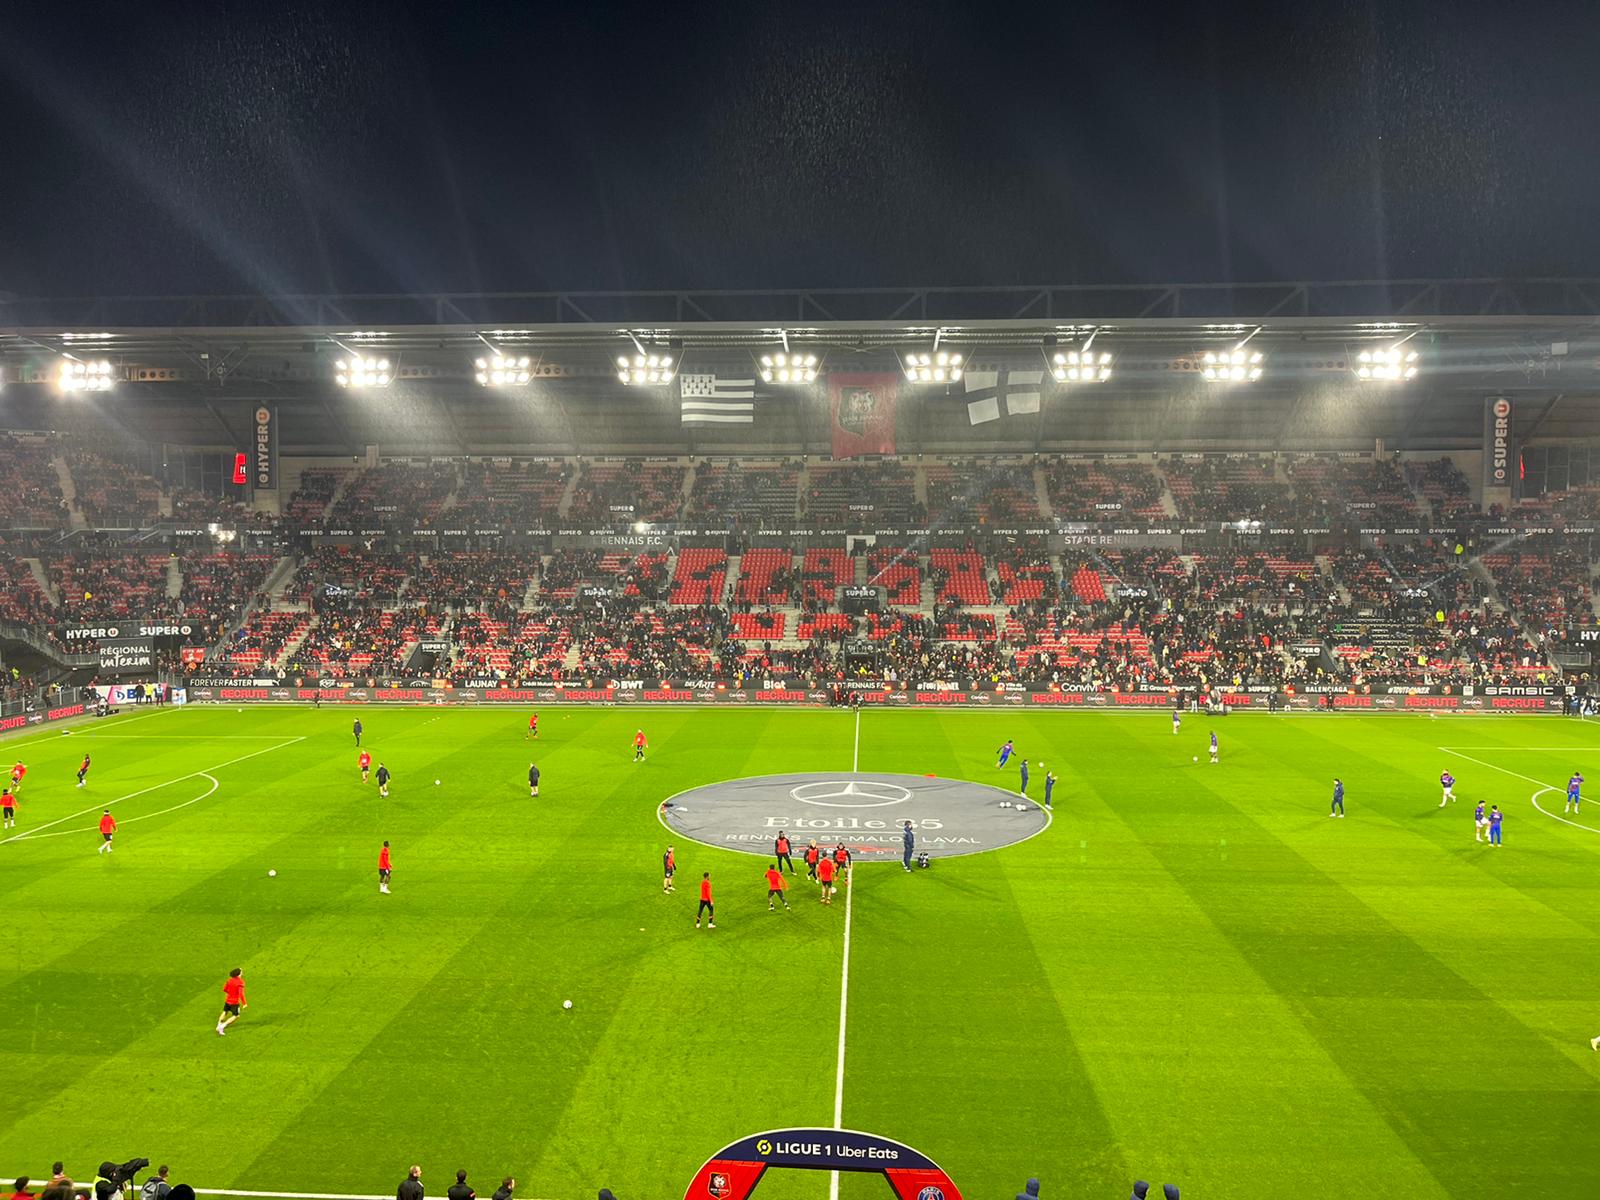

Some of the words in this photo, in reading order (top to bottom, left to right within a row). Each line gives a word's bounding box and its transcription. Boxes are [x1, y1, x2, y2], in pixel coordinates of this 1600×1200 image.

[1494, 418, 1508, 467] SUPER
[257, 425, 269, 472] HYPER
[66, 629, 106, 639] HYPER
[140, 626, 179, 636] SUPER
[100, 646, 150, 655] RÉGIONAL
[1061, 683, 1103, 692] Convivi
[220, 690, 268, 698] RECRUTE
[298, 690, 345, 698] RECRUTE
[375, 690, 422, 699] RECRUTE
[486, 691, 534, 699] RECRUTE
[565, 691, 613, 700] RECRUTE
[644, 691, 692, 700] RECRUTE
[756, 691, 804, 700] RECRUTE
[916, 693, 966, 702] RECRUTE
[1032, 694, 1082, 703] RECRUTE
[1115, 694, 1166, 703] RECRUTE
[1199, 696, 1250, 704] RRUTE
[1318, 697, 1371, 706] RCRUTE
[1405, 697, 1458, 707] RECRUTE
[1492, 698, 1544, 708] RECRUTE
[48, 704, 84, 720] RECRUTE
[762, 817, 886, 828] Etoile
[776, 1142, 821, 1155] LIGUE
[825, 1145, 831, 1156] 1
[836, 1146, 866, 1157] Uber
[868, 1147, 898, 1159] Eats
